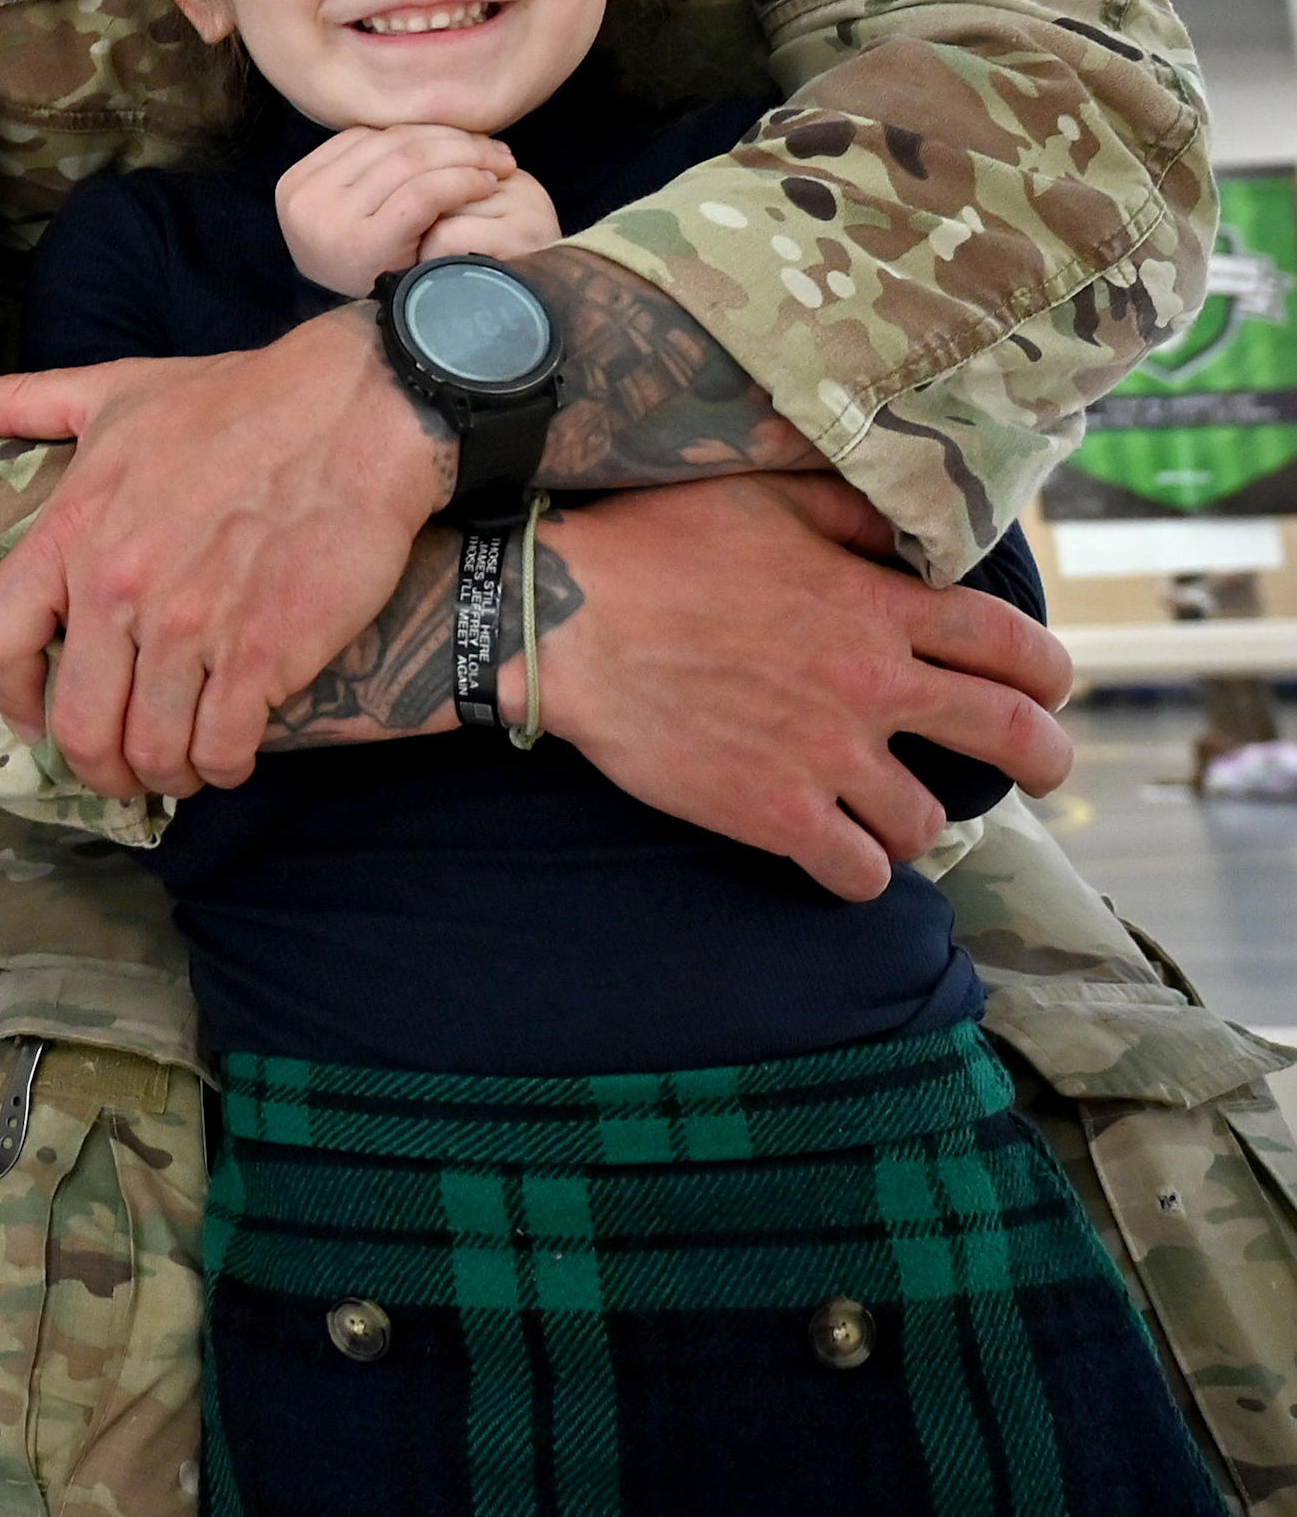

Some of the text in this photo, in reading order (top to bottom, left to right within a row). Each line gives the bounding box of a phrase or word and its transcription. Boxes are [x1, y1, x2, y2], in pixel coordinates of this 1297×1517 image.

[467, 541, 489, 689] JAMES JEFFREY LOLA
[480, 580, 496, 617] STILL
[457, 610, 469, 647] MEET
[479, 624, 491, 663] HERE
[457, 655, 468, 696] AGAIN
